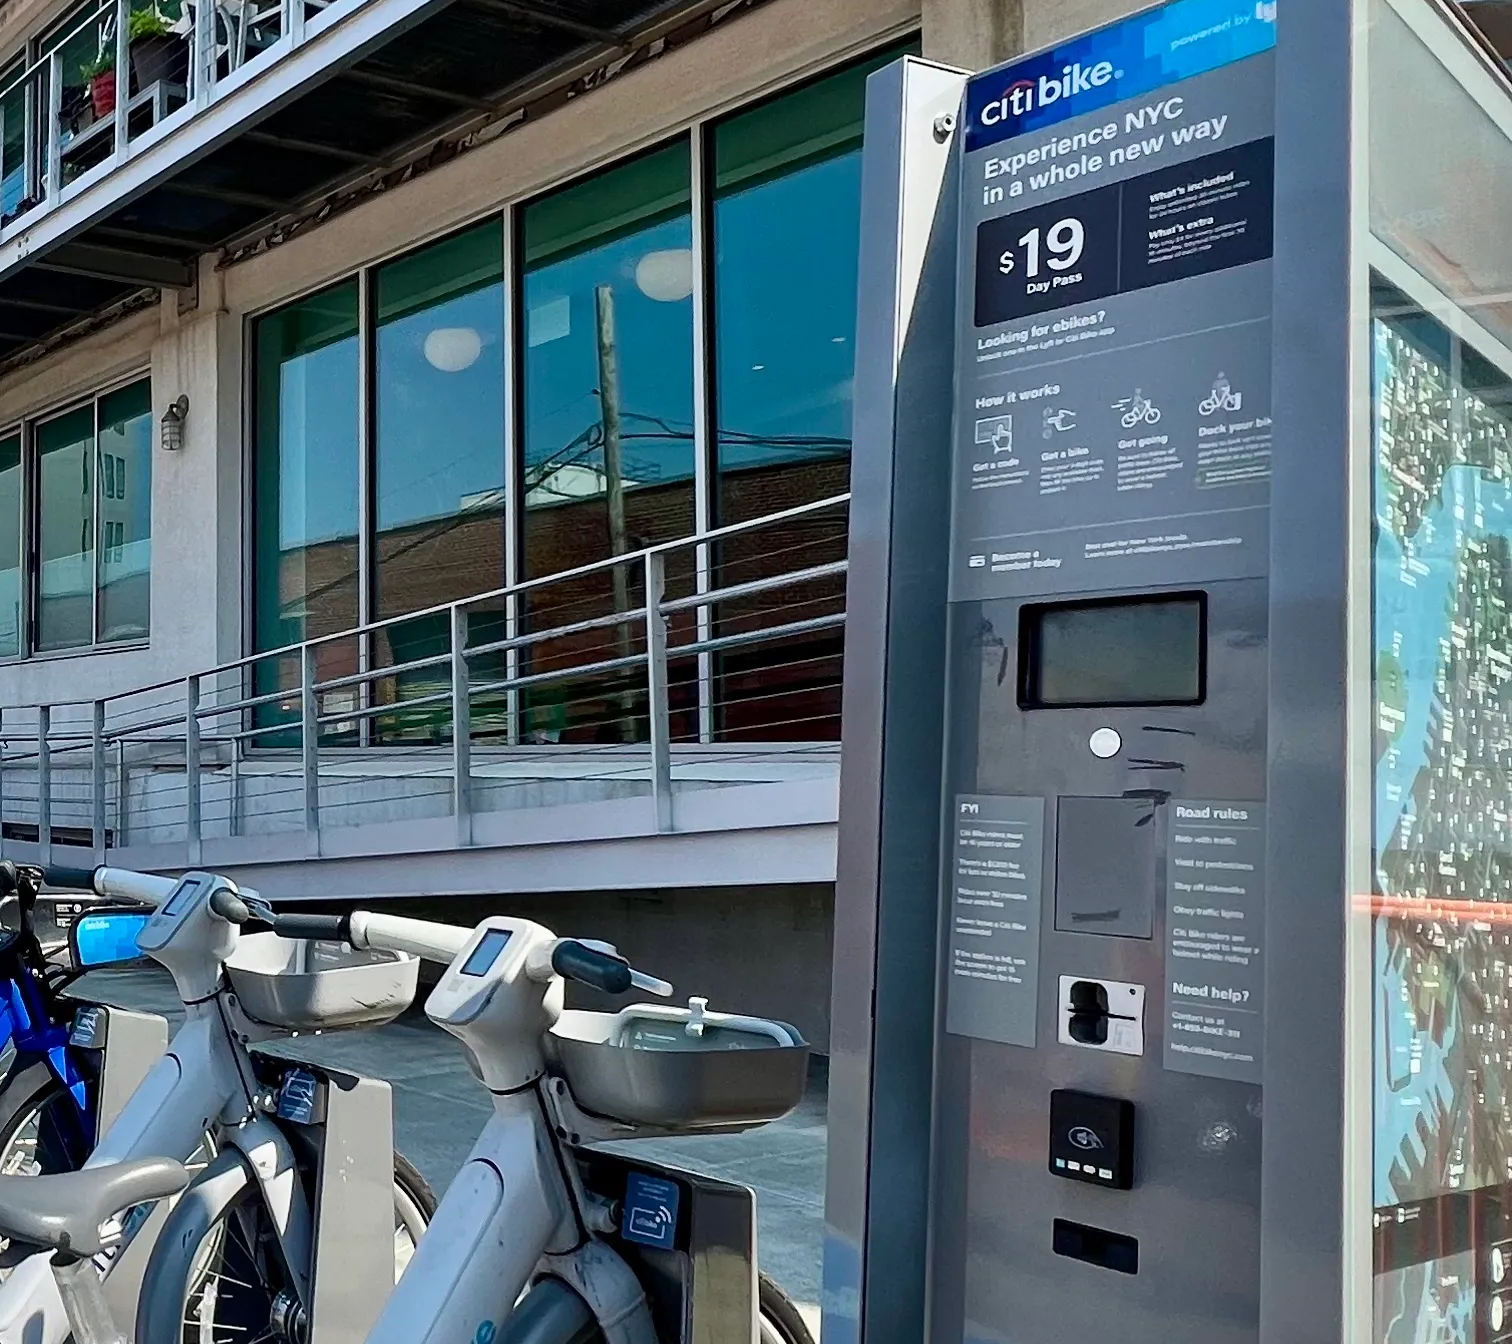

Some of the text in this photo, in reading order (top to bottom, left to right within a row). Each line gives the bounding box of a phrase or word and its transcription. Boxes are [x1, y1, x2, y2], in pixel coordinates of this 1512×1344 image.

[1170, 18, 1230, 52] powered
[1234, 12, 1252, 27] by
[984, 97, 1184, 180] Experience NYC
[983, 115, 1228, 205] in a whole new way
[1149, 187, 1186, 203] What's
[1187, 171, 1234, 192] included
[1149, 217, 1214, 240] What's extra
[1027, 273, 1083, 294] Day Pass
[977, 310, 1106, 350] Looking for ebikes?
[975, 384, 1060, 409] How it works
[960, 803, 979, 814] FYI
[1176, 806, 1248, 820] Road rules
[1172, 982, 1250, 1004] Need help?
